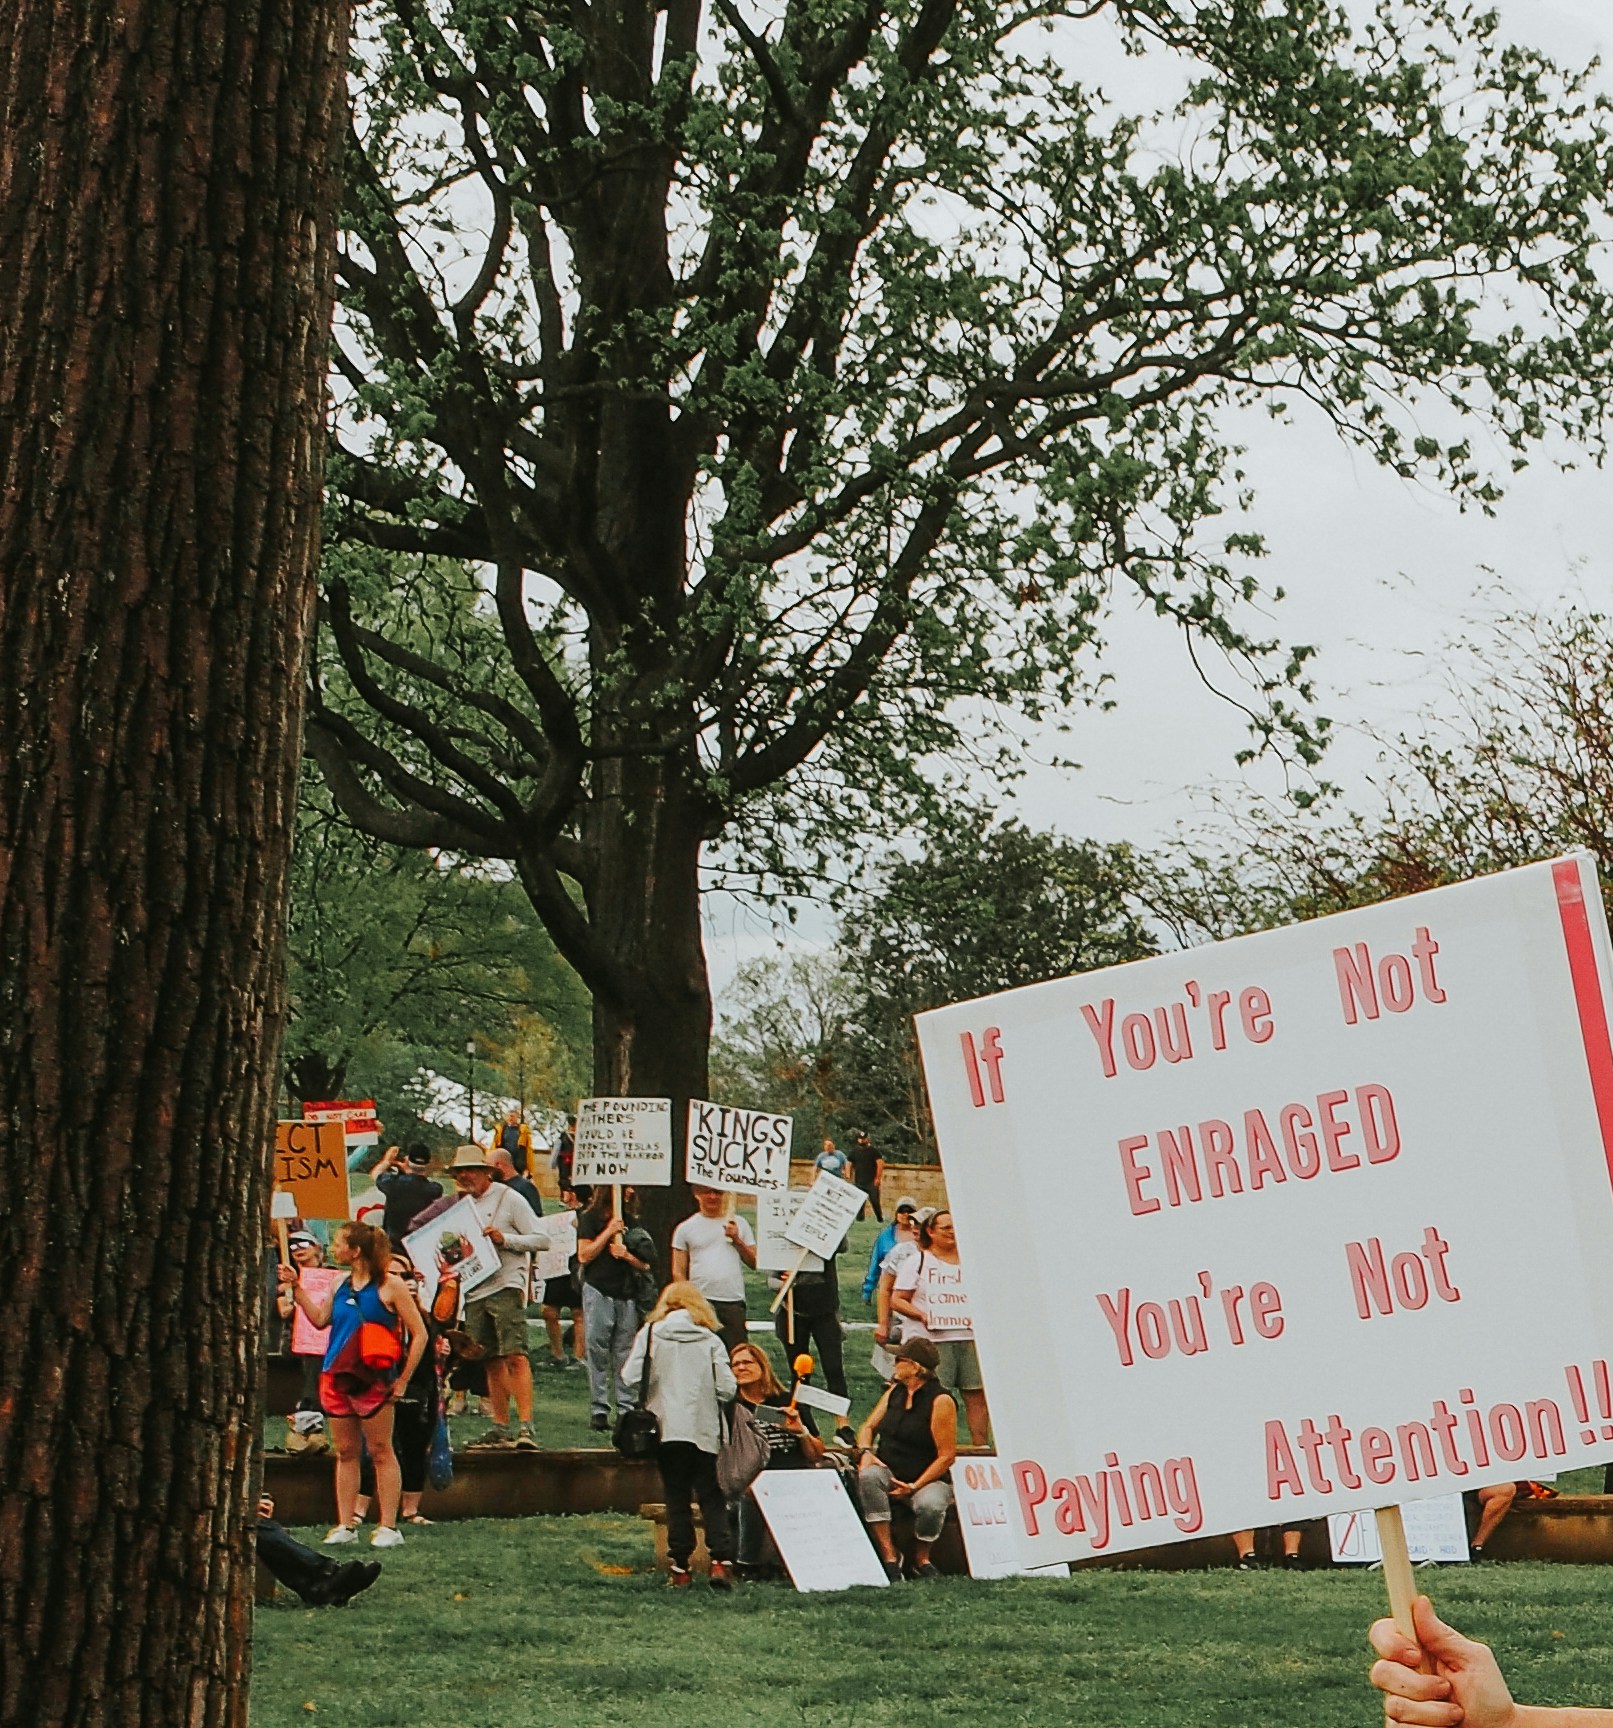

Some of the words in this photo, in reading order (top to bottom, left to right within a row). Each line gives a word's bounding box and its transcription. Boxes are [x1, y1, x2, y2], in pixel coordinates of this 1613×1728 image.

[959, 1027, 1005, 1108] If
[1081, 980, 1275, 1078] You're
[1333, 926, 1447, 1026] Not
[596, 1164, 628, 1175] NOW
[1117, 1083, 1401, 1216] ENRAGED
[1096, 1271, 1285, 1367] You're
[1345, 1226, 1461, 1319] Not
[1011, 1453, 1203, 1549] Paying
